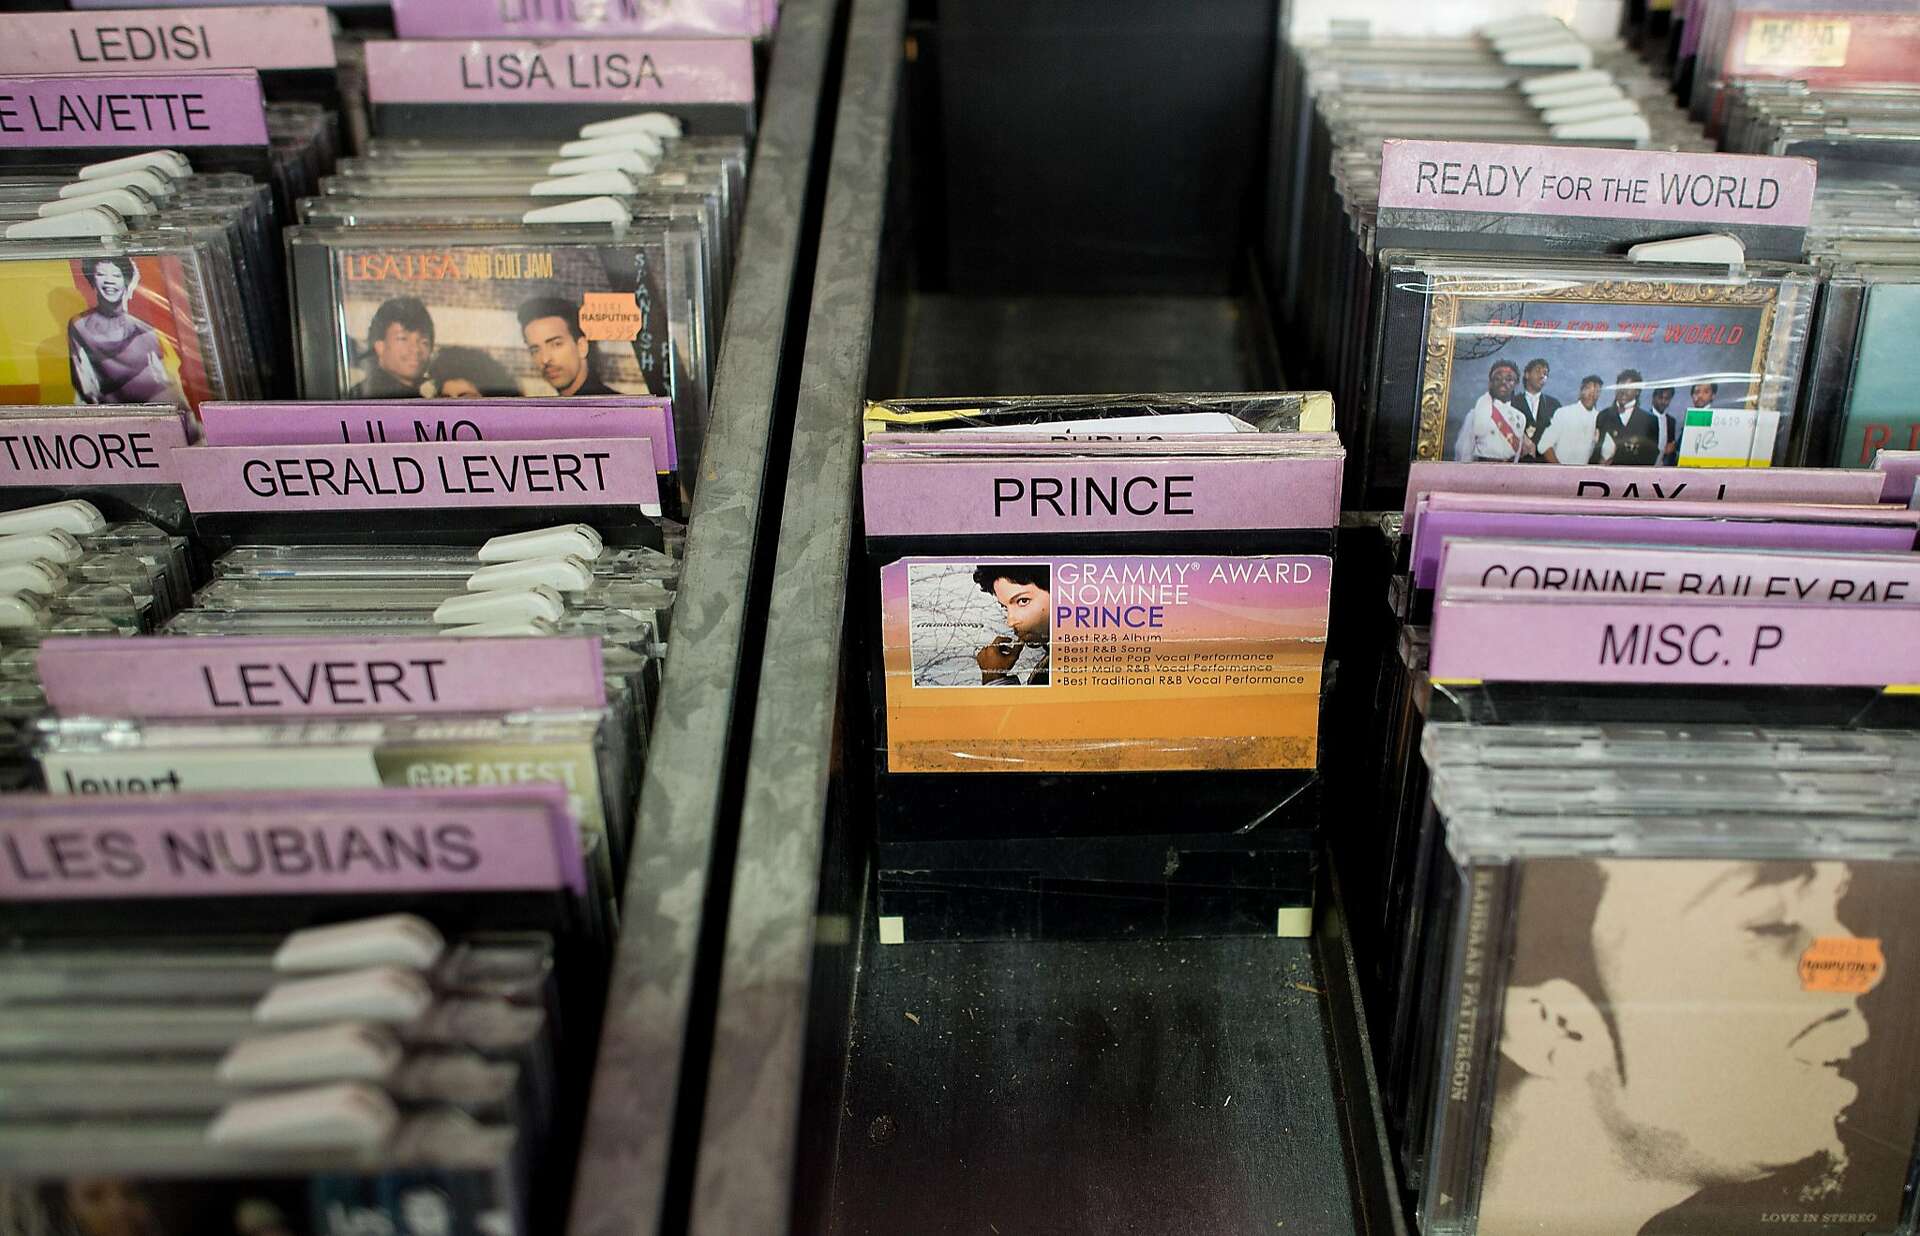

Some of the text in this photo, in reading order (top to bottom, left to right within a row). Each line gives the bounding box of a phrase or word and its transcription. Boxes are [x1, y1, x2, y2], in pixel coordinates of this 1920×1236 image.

[70, 25, 212, 62] LEDISI
[460, 54, 663, 90] LISA LISA
[29, 93, 210, 131] LAVETTE
[1416, 161, 1780, 209] READY FOR THE WORLD
[346, 253, 553, 281] LISA LISA AND CULT JAM
[581, 312, 640, 322] RASPUTIN'S
[1664, 323, 1745, 345] WORLD
[0, 433, 160, 470] TIMORE
[243, 452, 610, 497] GERALD LEVERT
[994, 475, 1195, 517] PRINCE
[1208, 563, 1313, 584] AWARD
[1057, 584, 1189, 605] NOMINEE
[1056, 605, 1164, 628] PRINCE
[1121, 645, 1152, 654] Song
[1156, 653, 1190, 661] Vocal
[1194, 652, 1274, 661] Performance
[1599, 624, 1784, 667] MISC. P
[201, 659, 446, 708] LEVERT
[1063, 674, 1305, 686] Best Traditional R&B Vocal Performance
[2, 823, 482, 881] LES NUBIANS
[1761, 1212, 1877, 1223] LOVE IN STEREO
